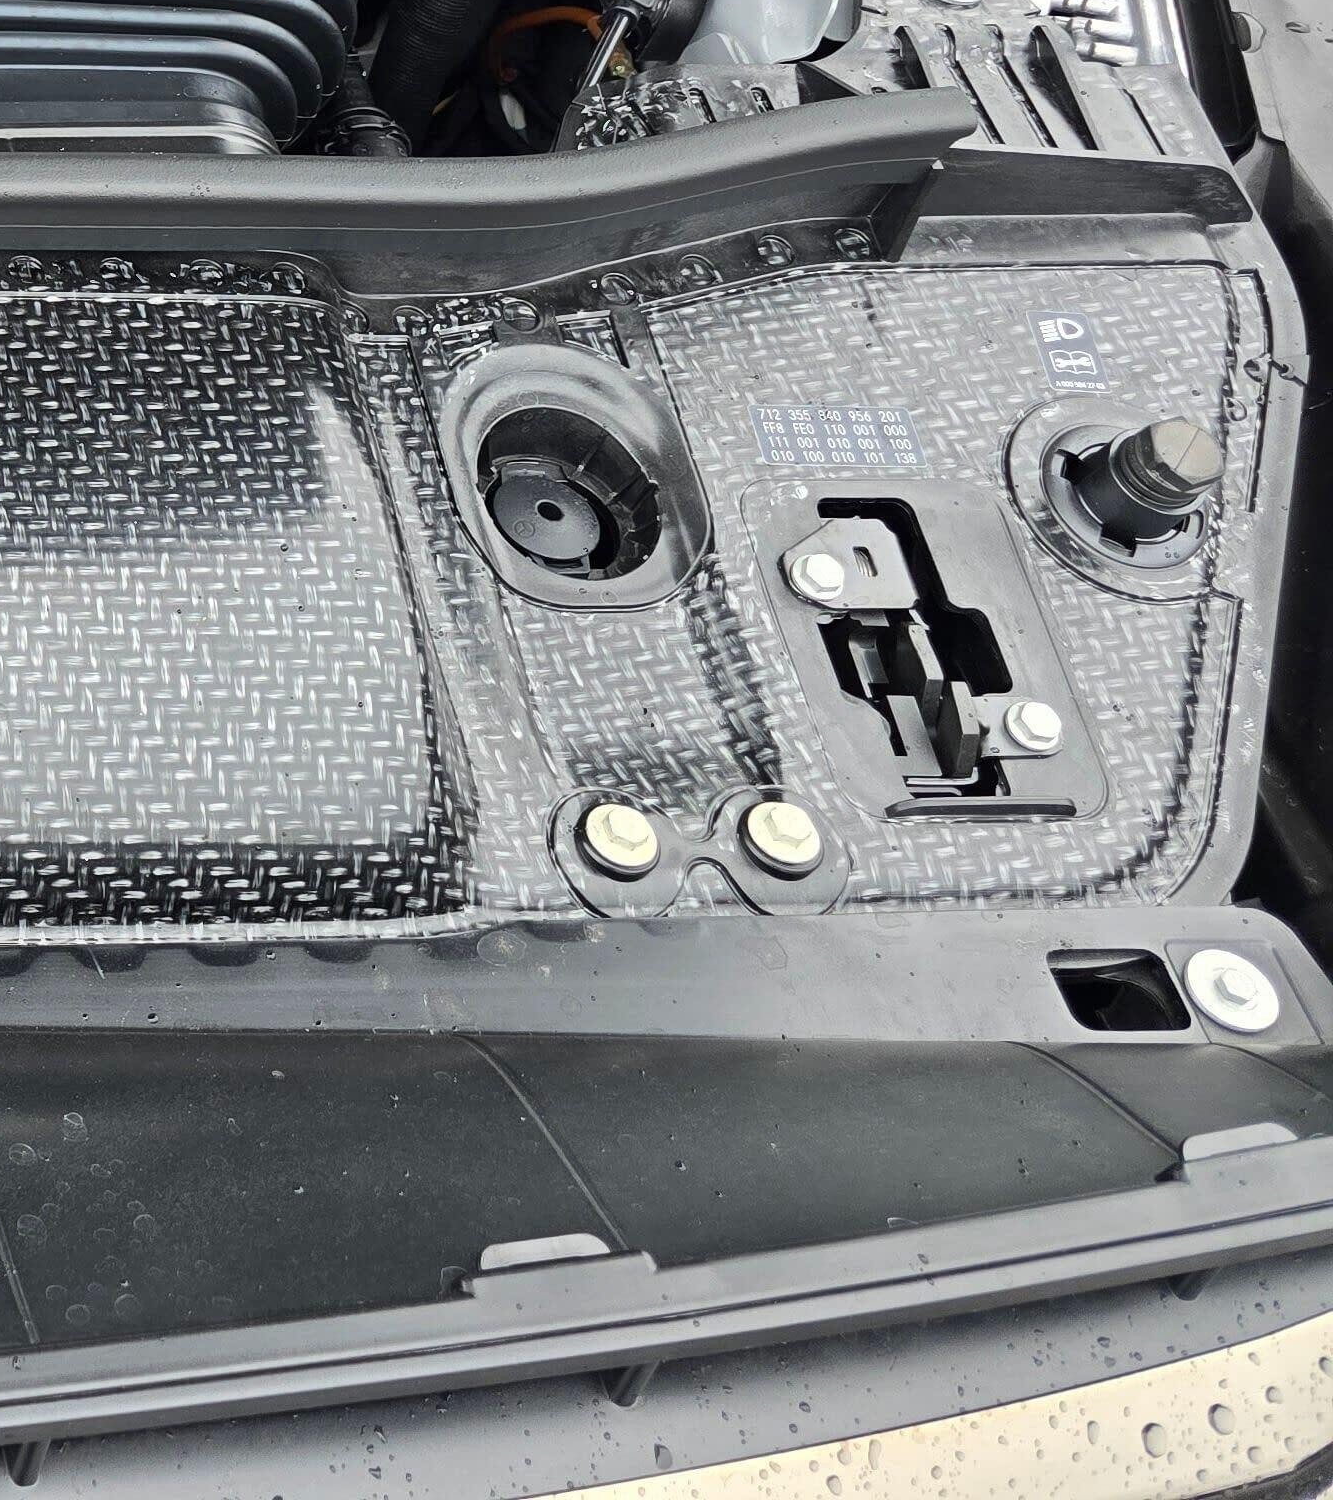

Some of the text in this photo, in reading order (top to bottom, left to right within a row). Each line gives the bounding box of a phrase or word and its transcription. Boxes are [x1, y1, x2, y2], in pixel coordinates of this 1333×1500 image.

[757, 408, 783, 420] 712
[788, 409, 812, 421] 355
[848, 410, 872, 422] 956
[878, 411, 902, 423] 201
[763, 422, 907, 437] FF8 FE0 110 001 000
[768, 436, 912, 451] 111 001 010 001 100
[771, 450, 918, 464] 010 100 010 101 138
